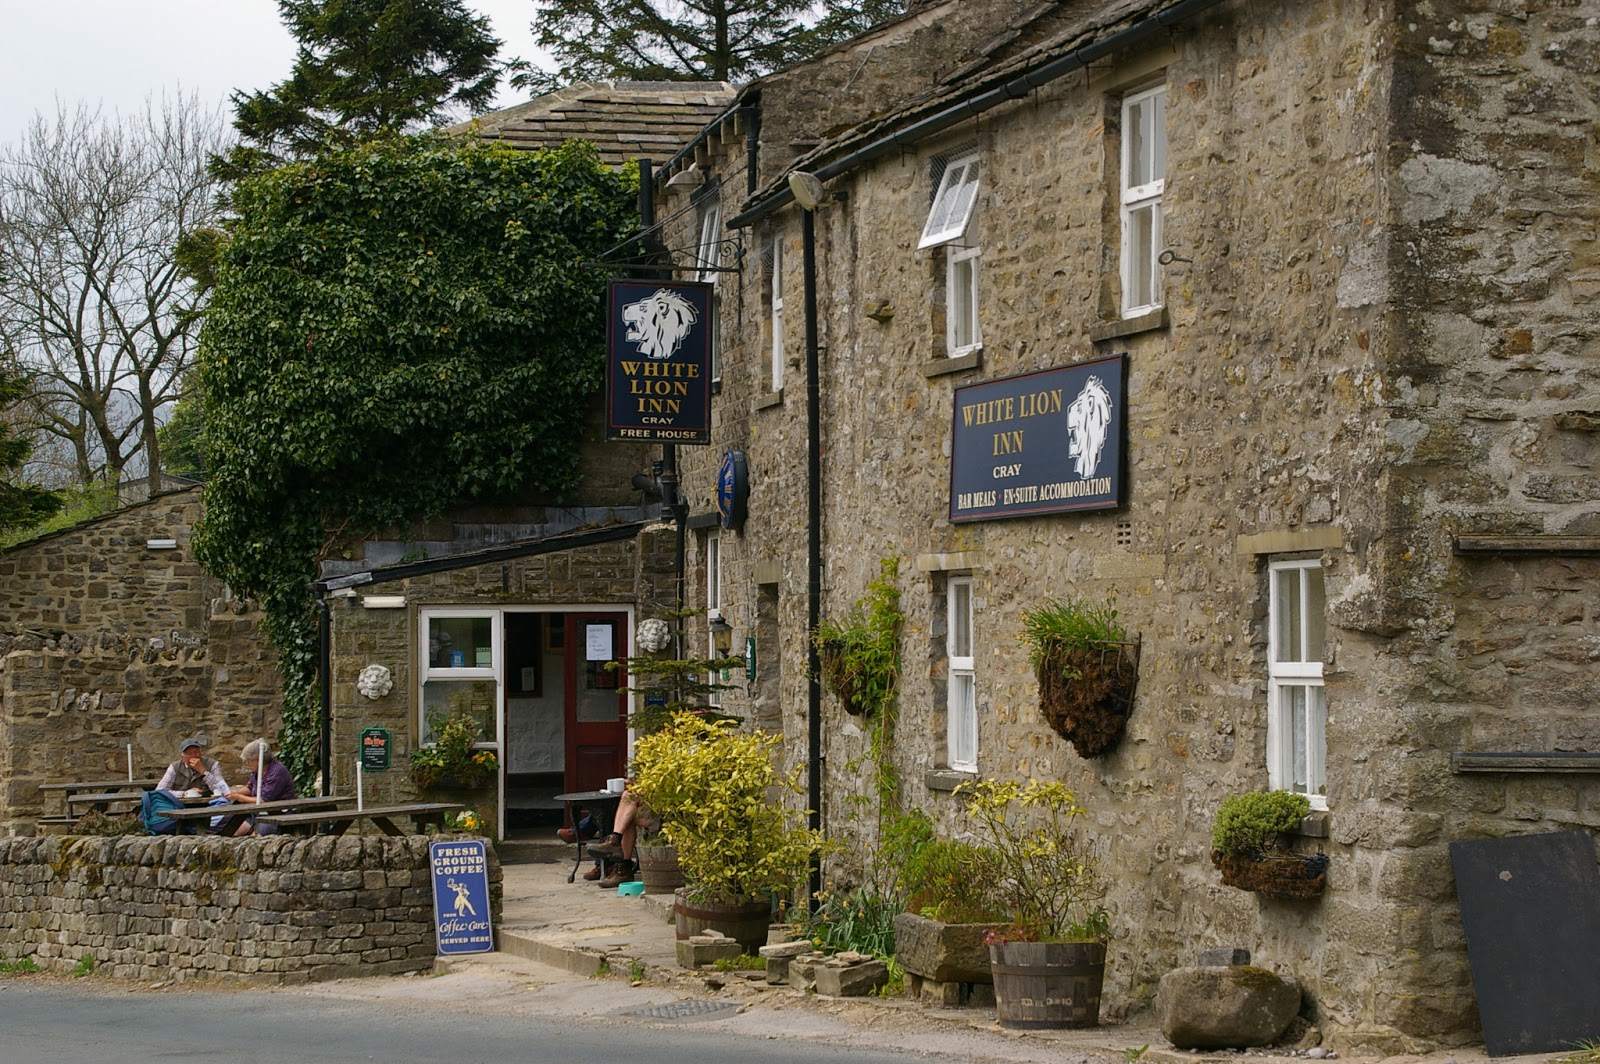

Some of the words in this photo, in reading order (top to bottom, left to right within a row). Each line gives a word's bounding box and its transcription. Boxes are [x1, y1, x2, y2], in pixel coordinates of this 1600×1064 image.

[620, 360, 699, 378] WHITE
[630, 380, 689, 396] LION
[637, 398, 681, 414] INN
[962, 397, 1014, 427] WHITE
[1019, 389, 1063, 418] LION
[642, 416, 674, 425] CRAY
[620, 429, 650, 438] FREE
[656, 430, 697, 439] HOUSE
[992, 430, 1024, 456] INN
[993, 464, 1022, 479] CRAY
[957, 493, 972, 510] BAR
[973, 490, 997, 508] MEALS
[1039, 477, 1112, 501] ACCOMMODATION
[172, 631, 200, 645] Private
[437, 847, 478, 857] FRESH
[433, 856, 484, 866] GROUND
[435, 865, 484, 875] COFFEE
[439, 918, 468, 937] Coffee
[468, 921, 488, 931] Care
